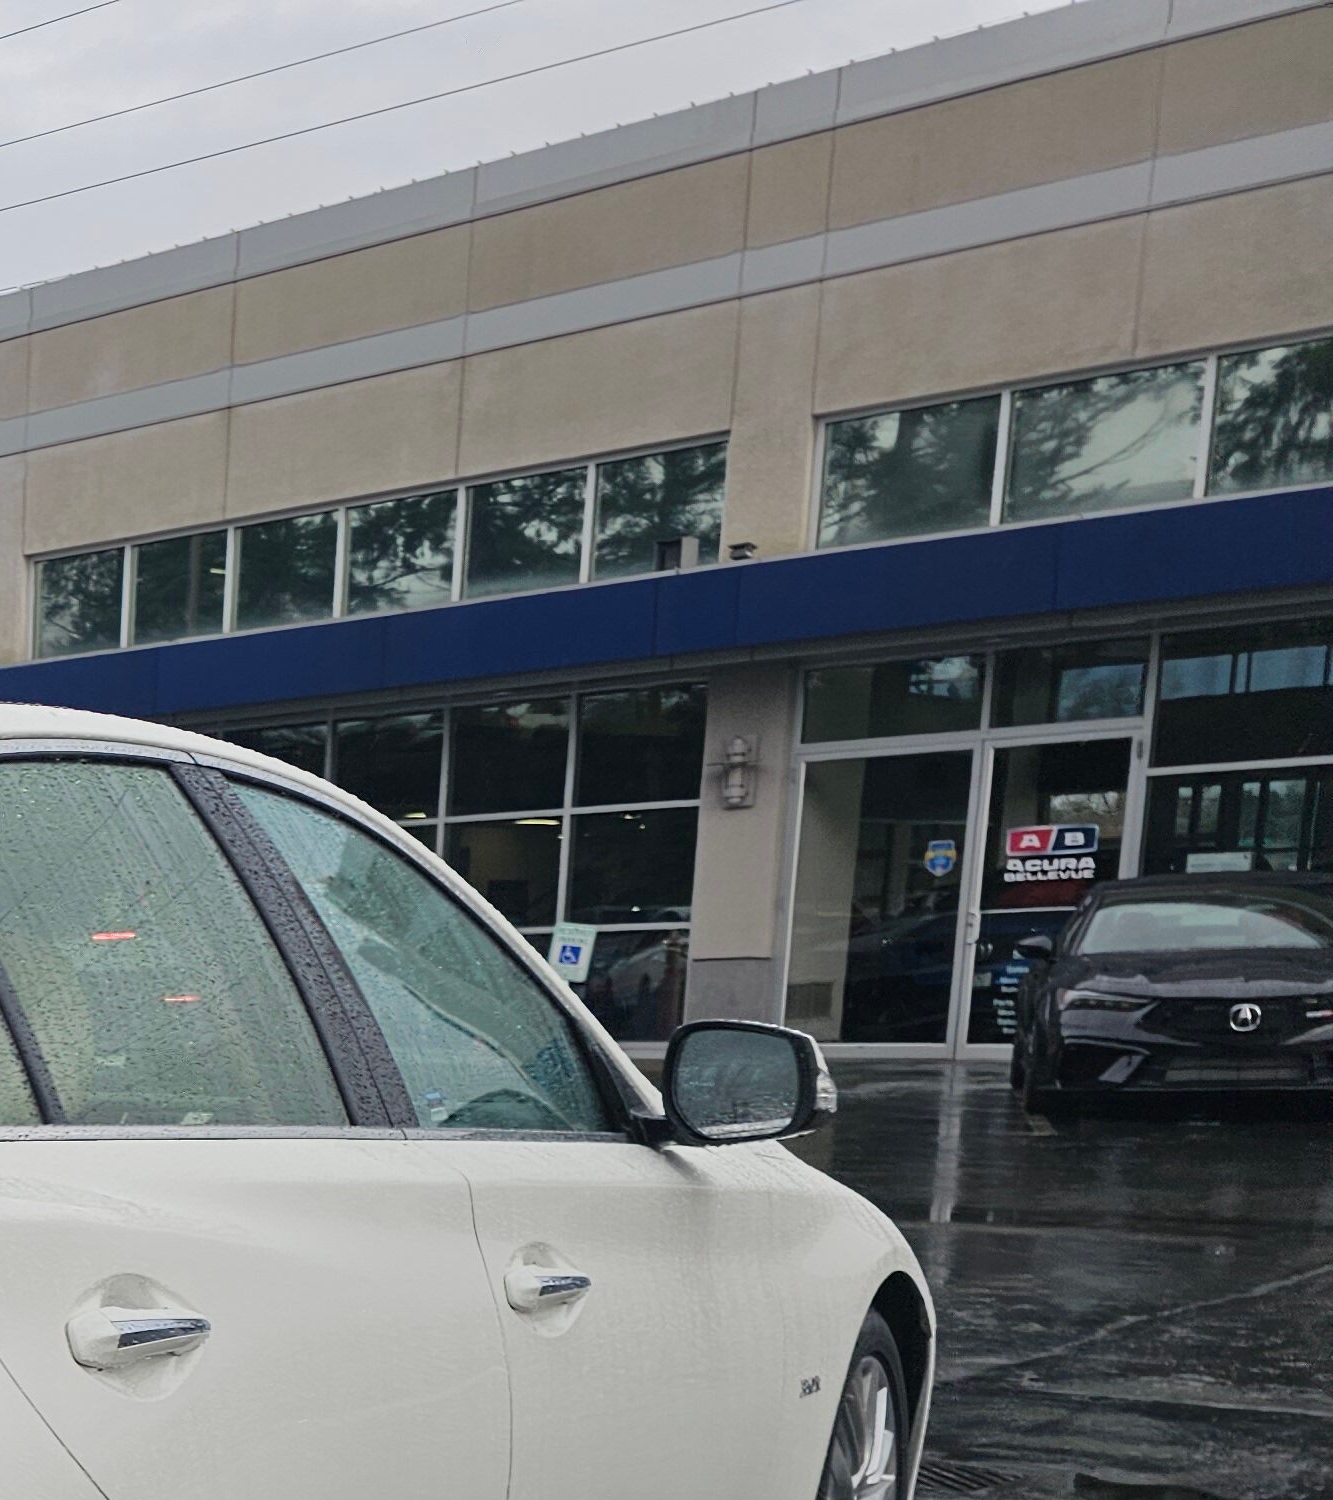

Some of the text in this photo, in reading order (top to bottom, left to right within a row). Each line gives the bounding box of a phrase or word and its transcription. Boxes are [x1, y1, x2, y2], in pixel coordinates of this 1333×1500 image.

[1019, 831, 1086, 849] A B
[1005, 856, 1096, 873] ACURA
[1003, 868, 1095, 883] BELLEVUE
